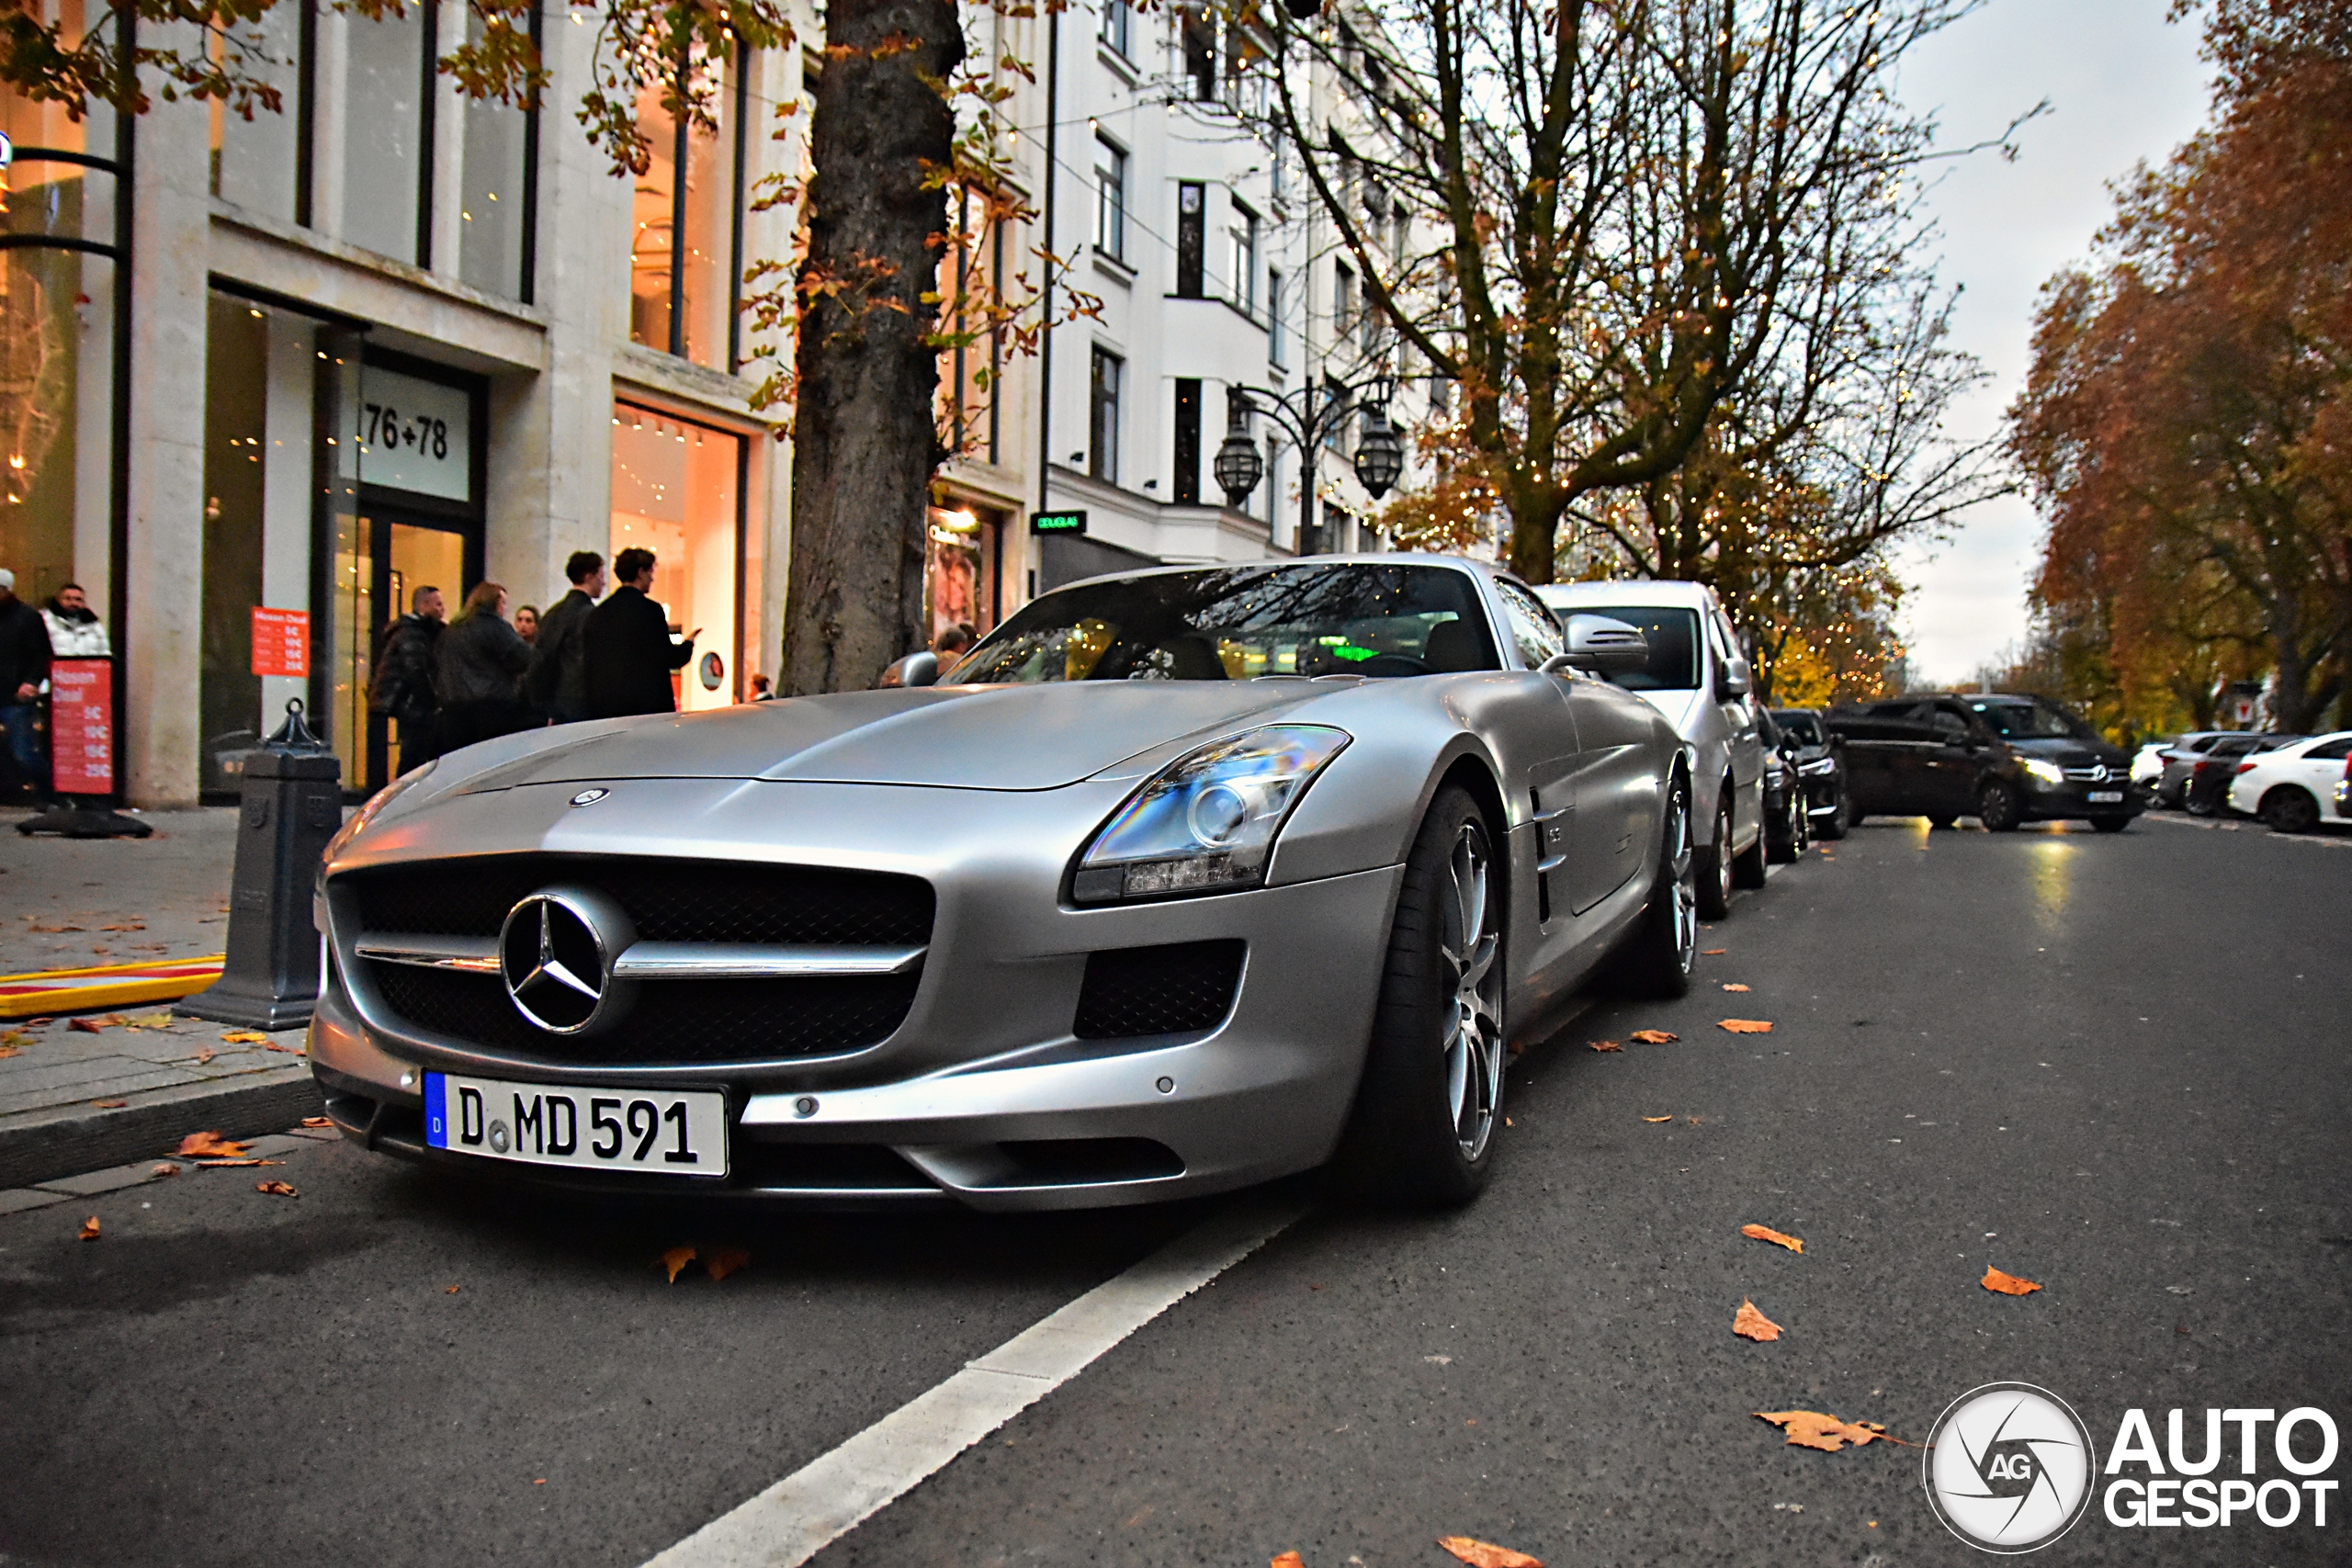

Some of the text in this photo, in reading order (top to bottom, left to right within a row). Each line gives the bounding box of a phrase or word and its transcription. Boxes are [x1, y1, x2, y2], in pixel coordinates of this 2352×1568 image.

[365, 402, 447, 460] 76+78
[1037, 516, 1079, 529] DOUGLAS
[433, 1087, 697, 1164] D D MD 591
